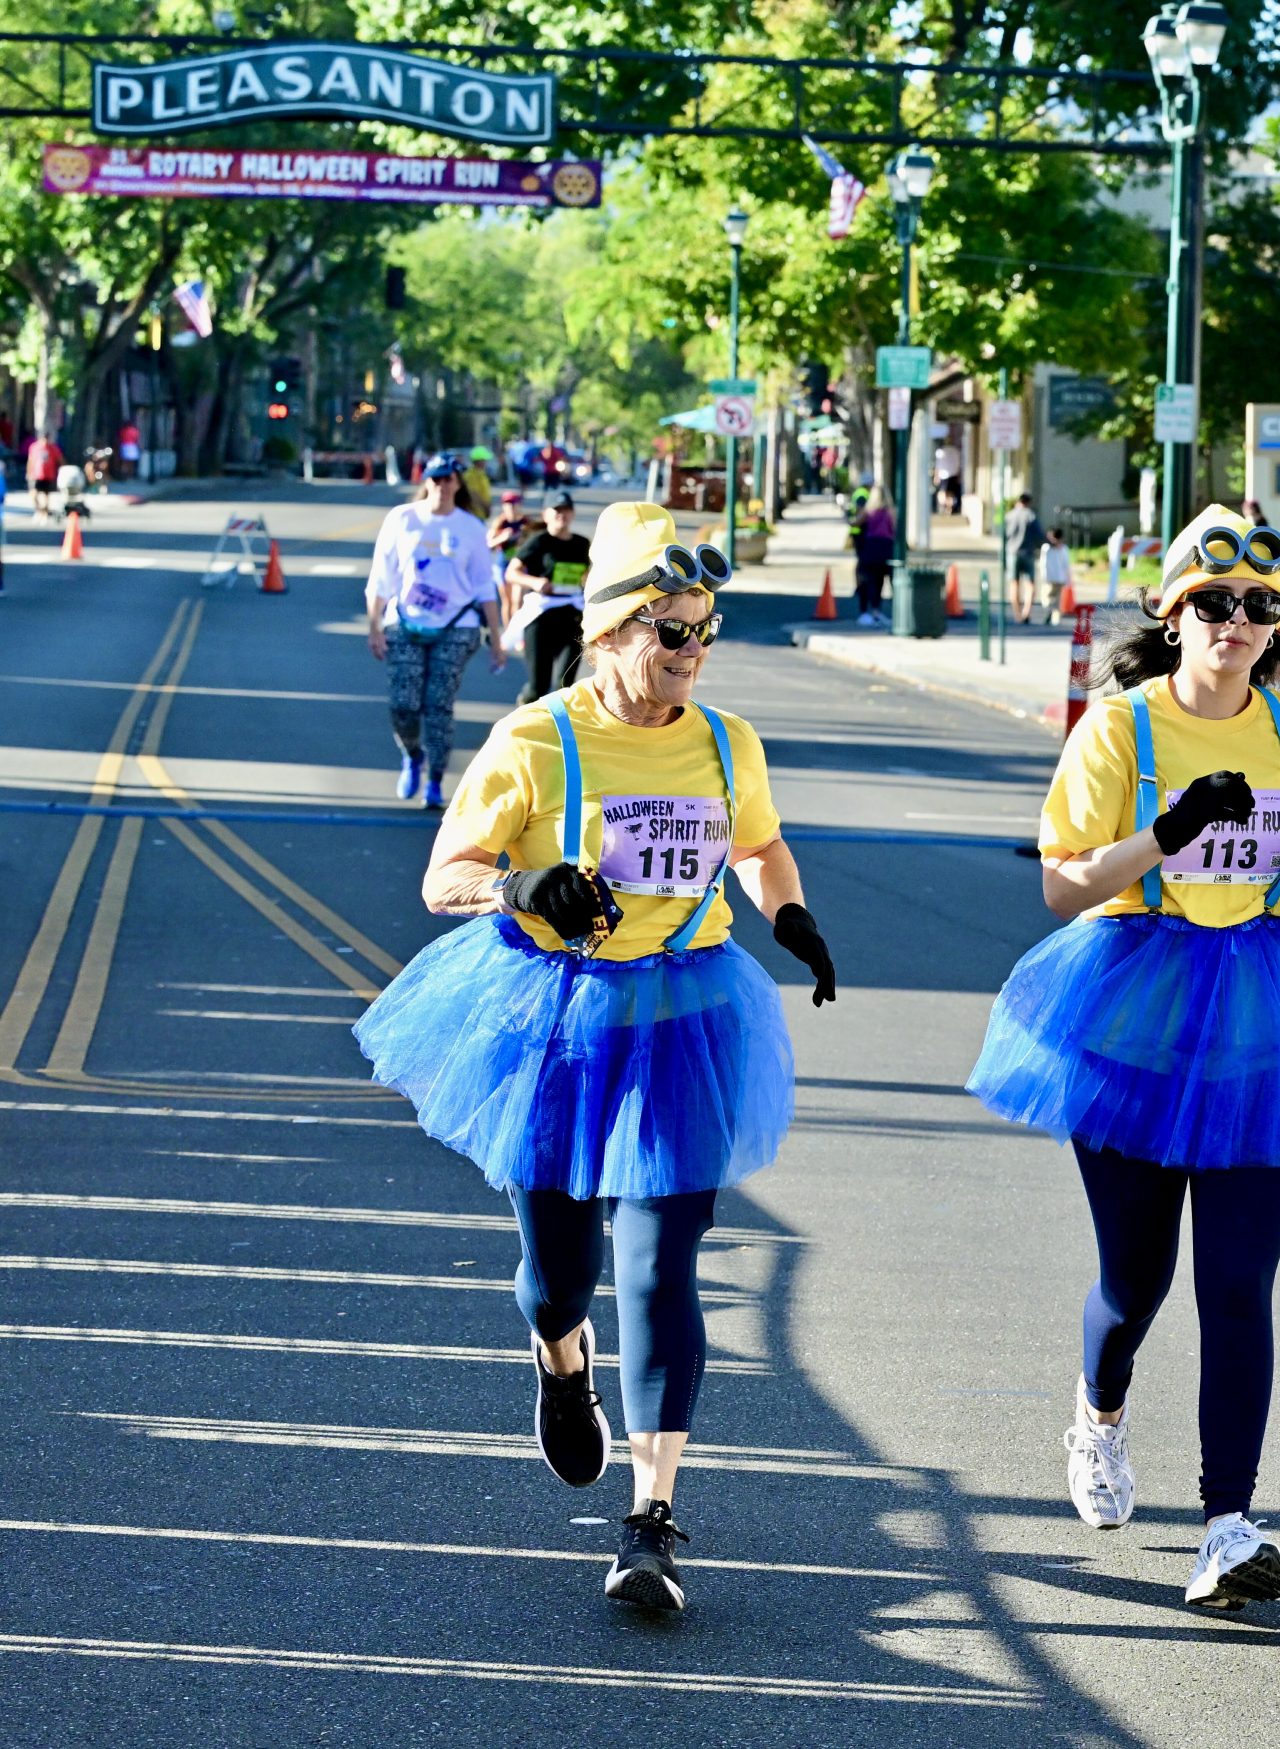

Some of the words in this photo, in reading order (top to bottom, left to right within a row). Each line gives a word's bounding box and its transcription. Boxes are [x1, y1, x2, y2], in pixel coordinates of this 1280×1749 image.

[106, 55, 541, 132] PLEASANTON
[149, 151, 234, 178] ROTARY
[241, 154, 367, 181] HALLOWEEN
[374, 159, 446, 185] SPIRIT
[453, 163, 499, 187] RUN
[604, 801, 675, 825] HALLOWEEN
[685, 803, 696, 811] 5K
[648, 818, 700, 844] SPIRIT
[703, 819, 728, 844] RUN
[638, 846, 699, 880] 115
[1201, 838, 1258, 869] 113
